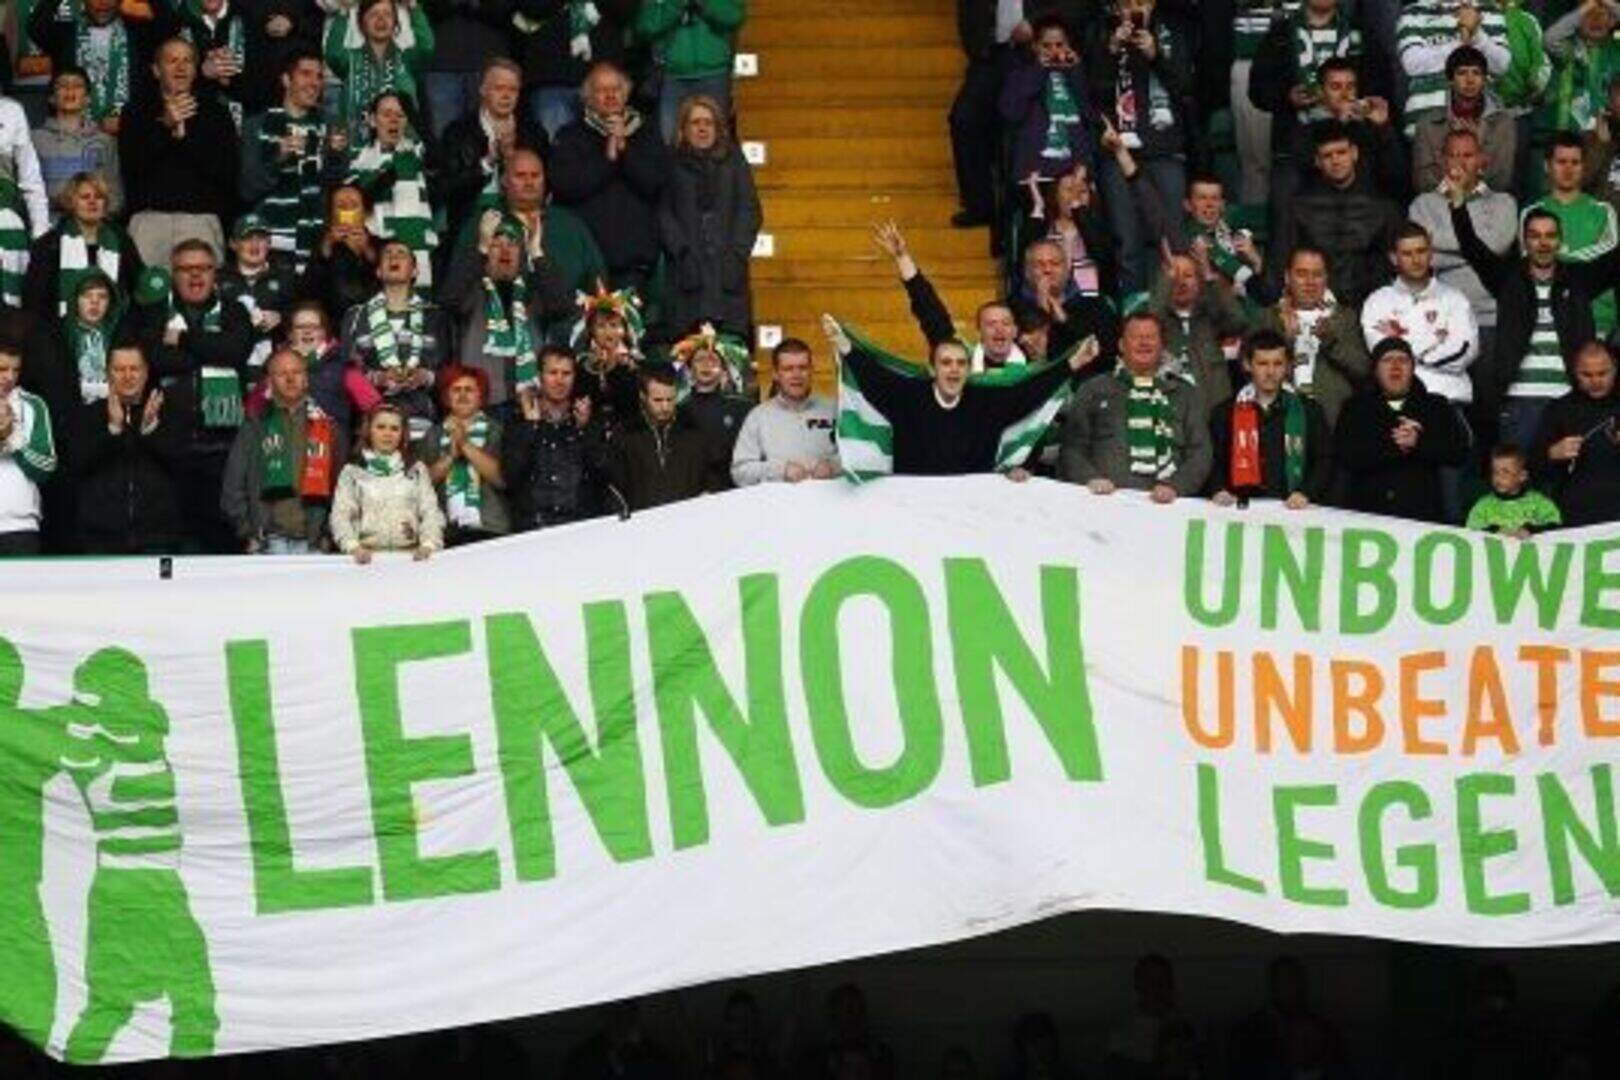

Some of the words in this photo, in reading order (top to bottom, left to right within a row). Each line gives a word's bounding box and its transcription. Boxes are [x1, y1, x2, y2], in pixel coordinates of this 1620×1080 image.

[1184, 519, 1620, 634] UNBOWE
[228, 556, 1103, 914] LENNON
[1180, 645, 1620, 757] UNBEATE
[1196, 763, 1620, 916] LEGEN
